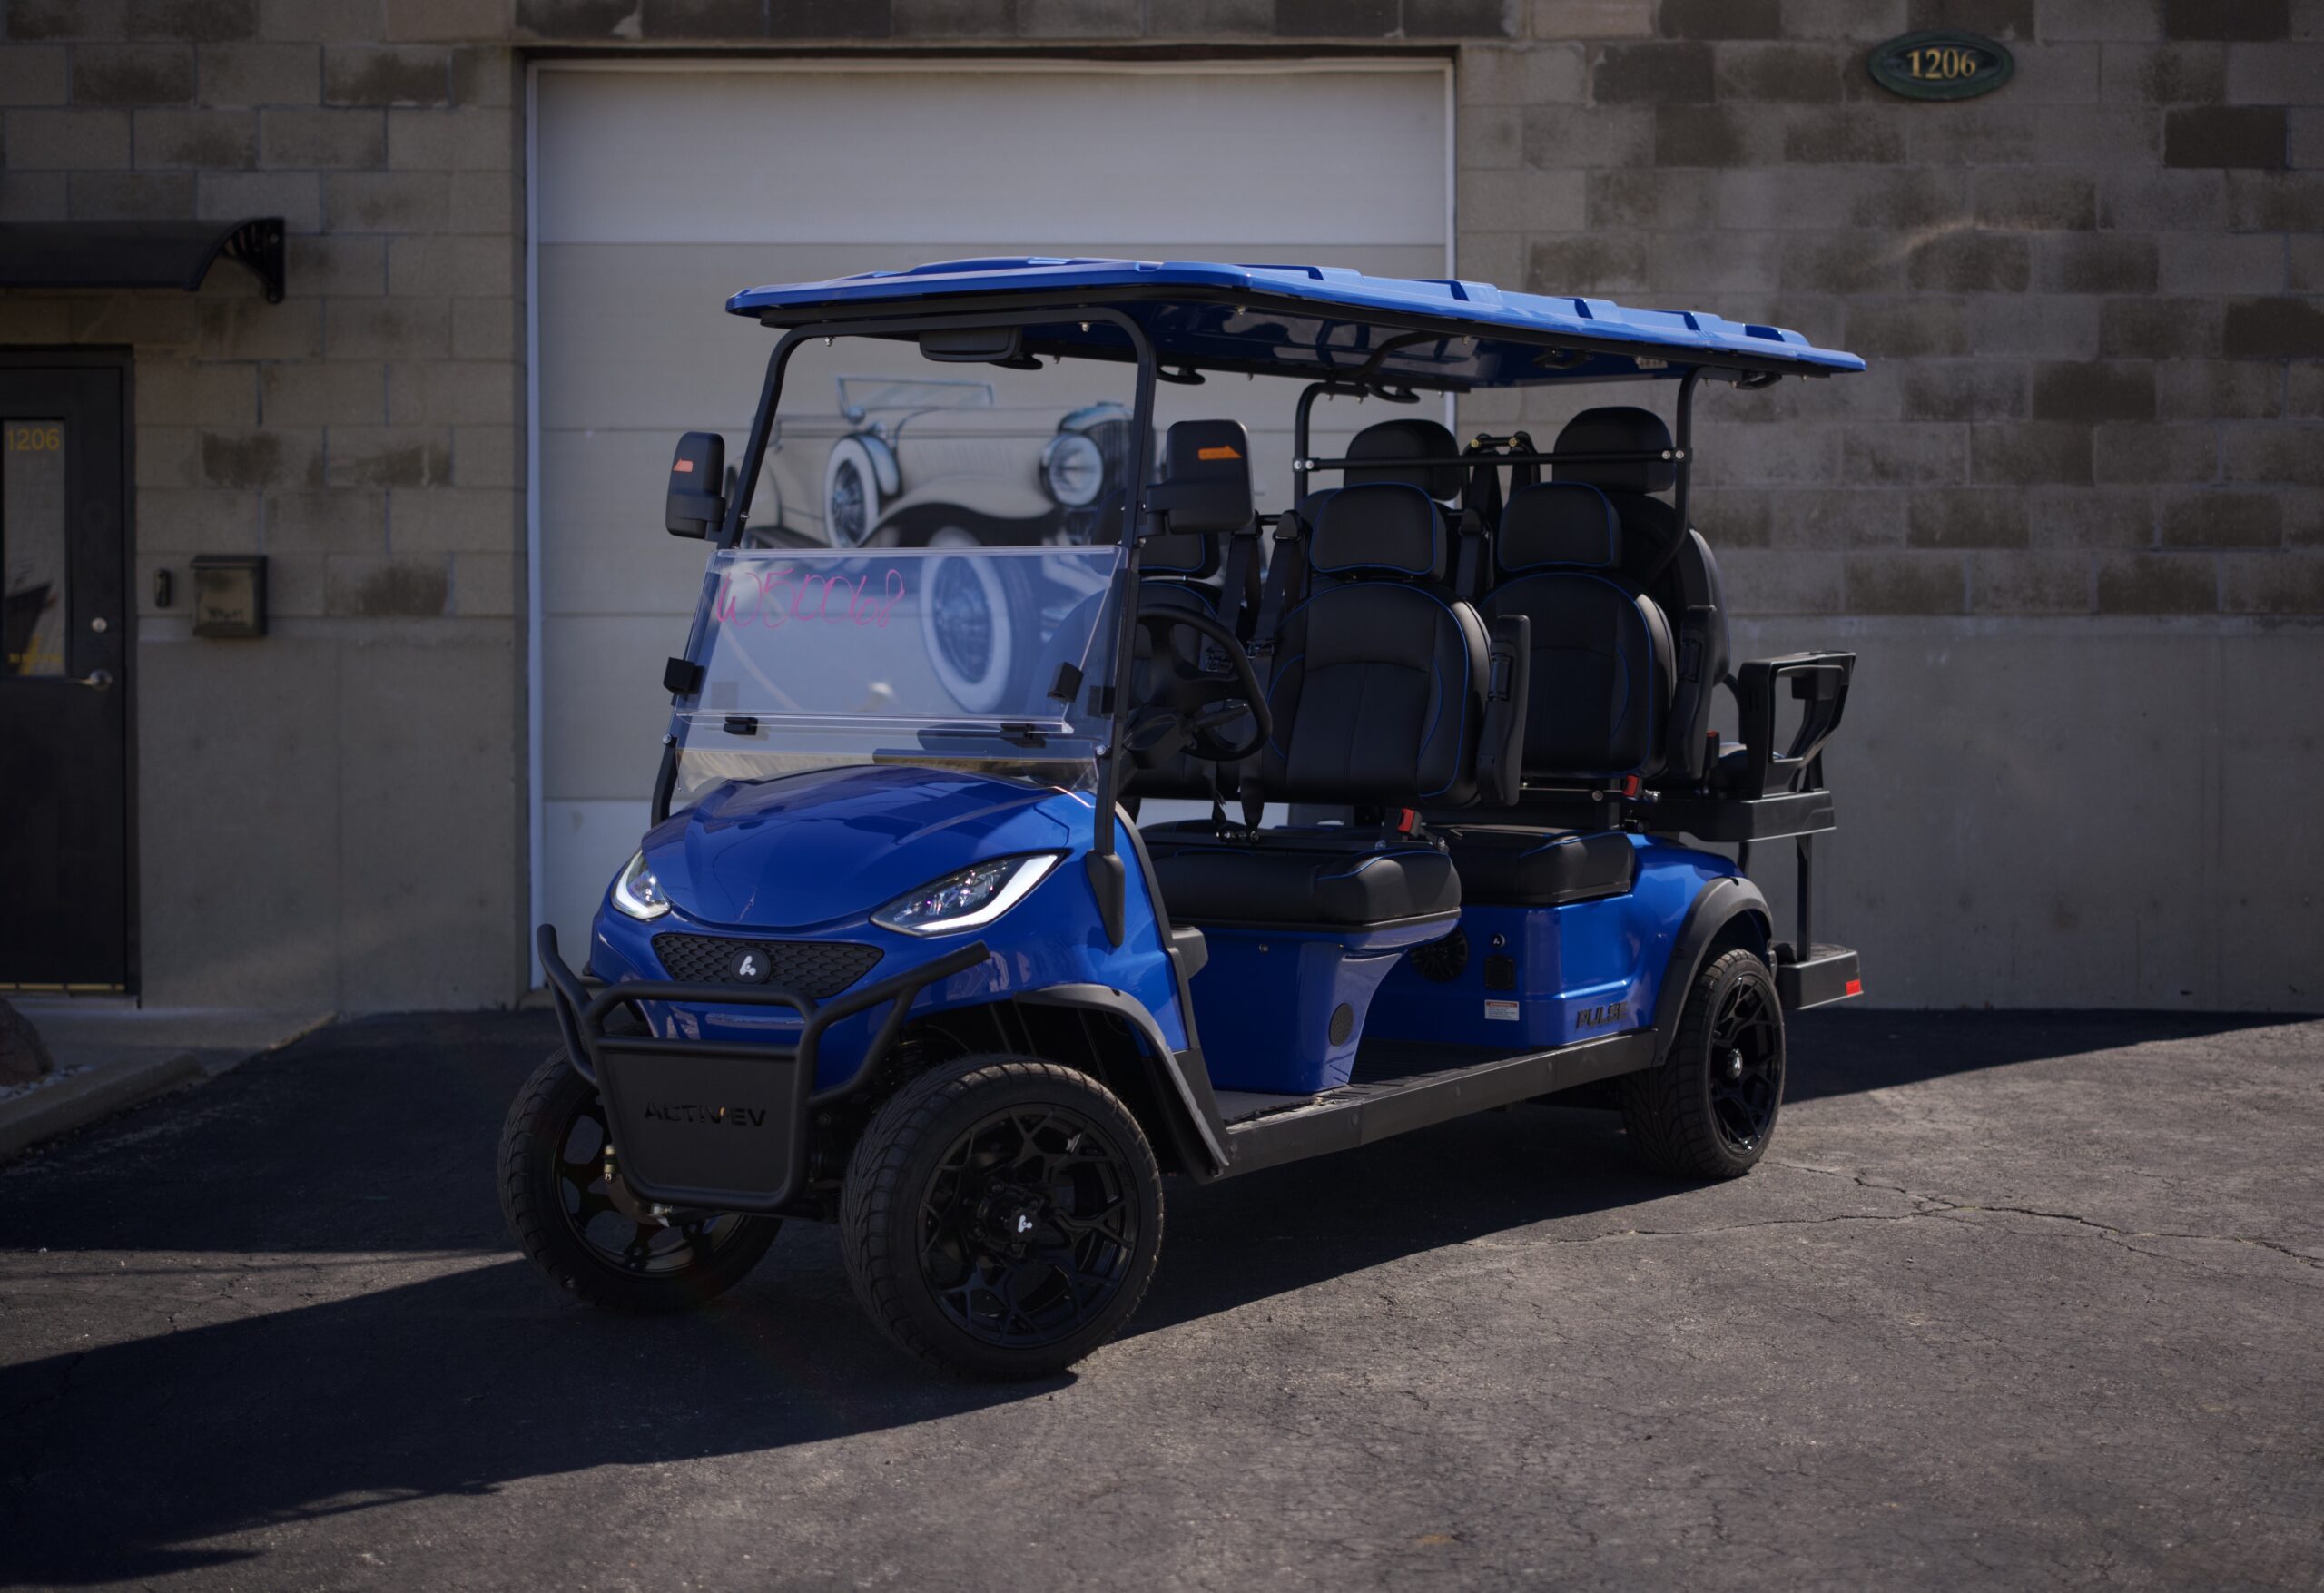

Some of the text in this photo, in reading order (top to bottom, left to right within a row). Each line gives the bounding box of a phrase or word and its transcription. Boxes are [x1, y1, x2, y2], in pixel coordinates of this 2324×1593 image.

[1907, 48, 1976, 79] 1206
[7, 428, 60, 451] 1206
[1576, 1001, 1628, 1029] PULSE
